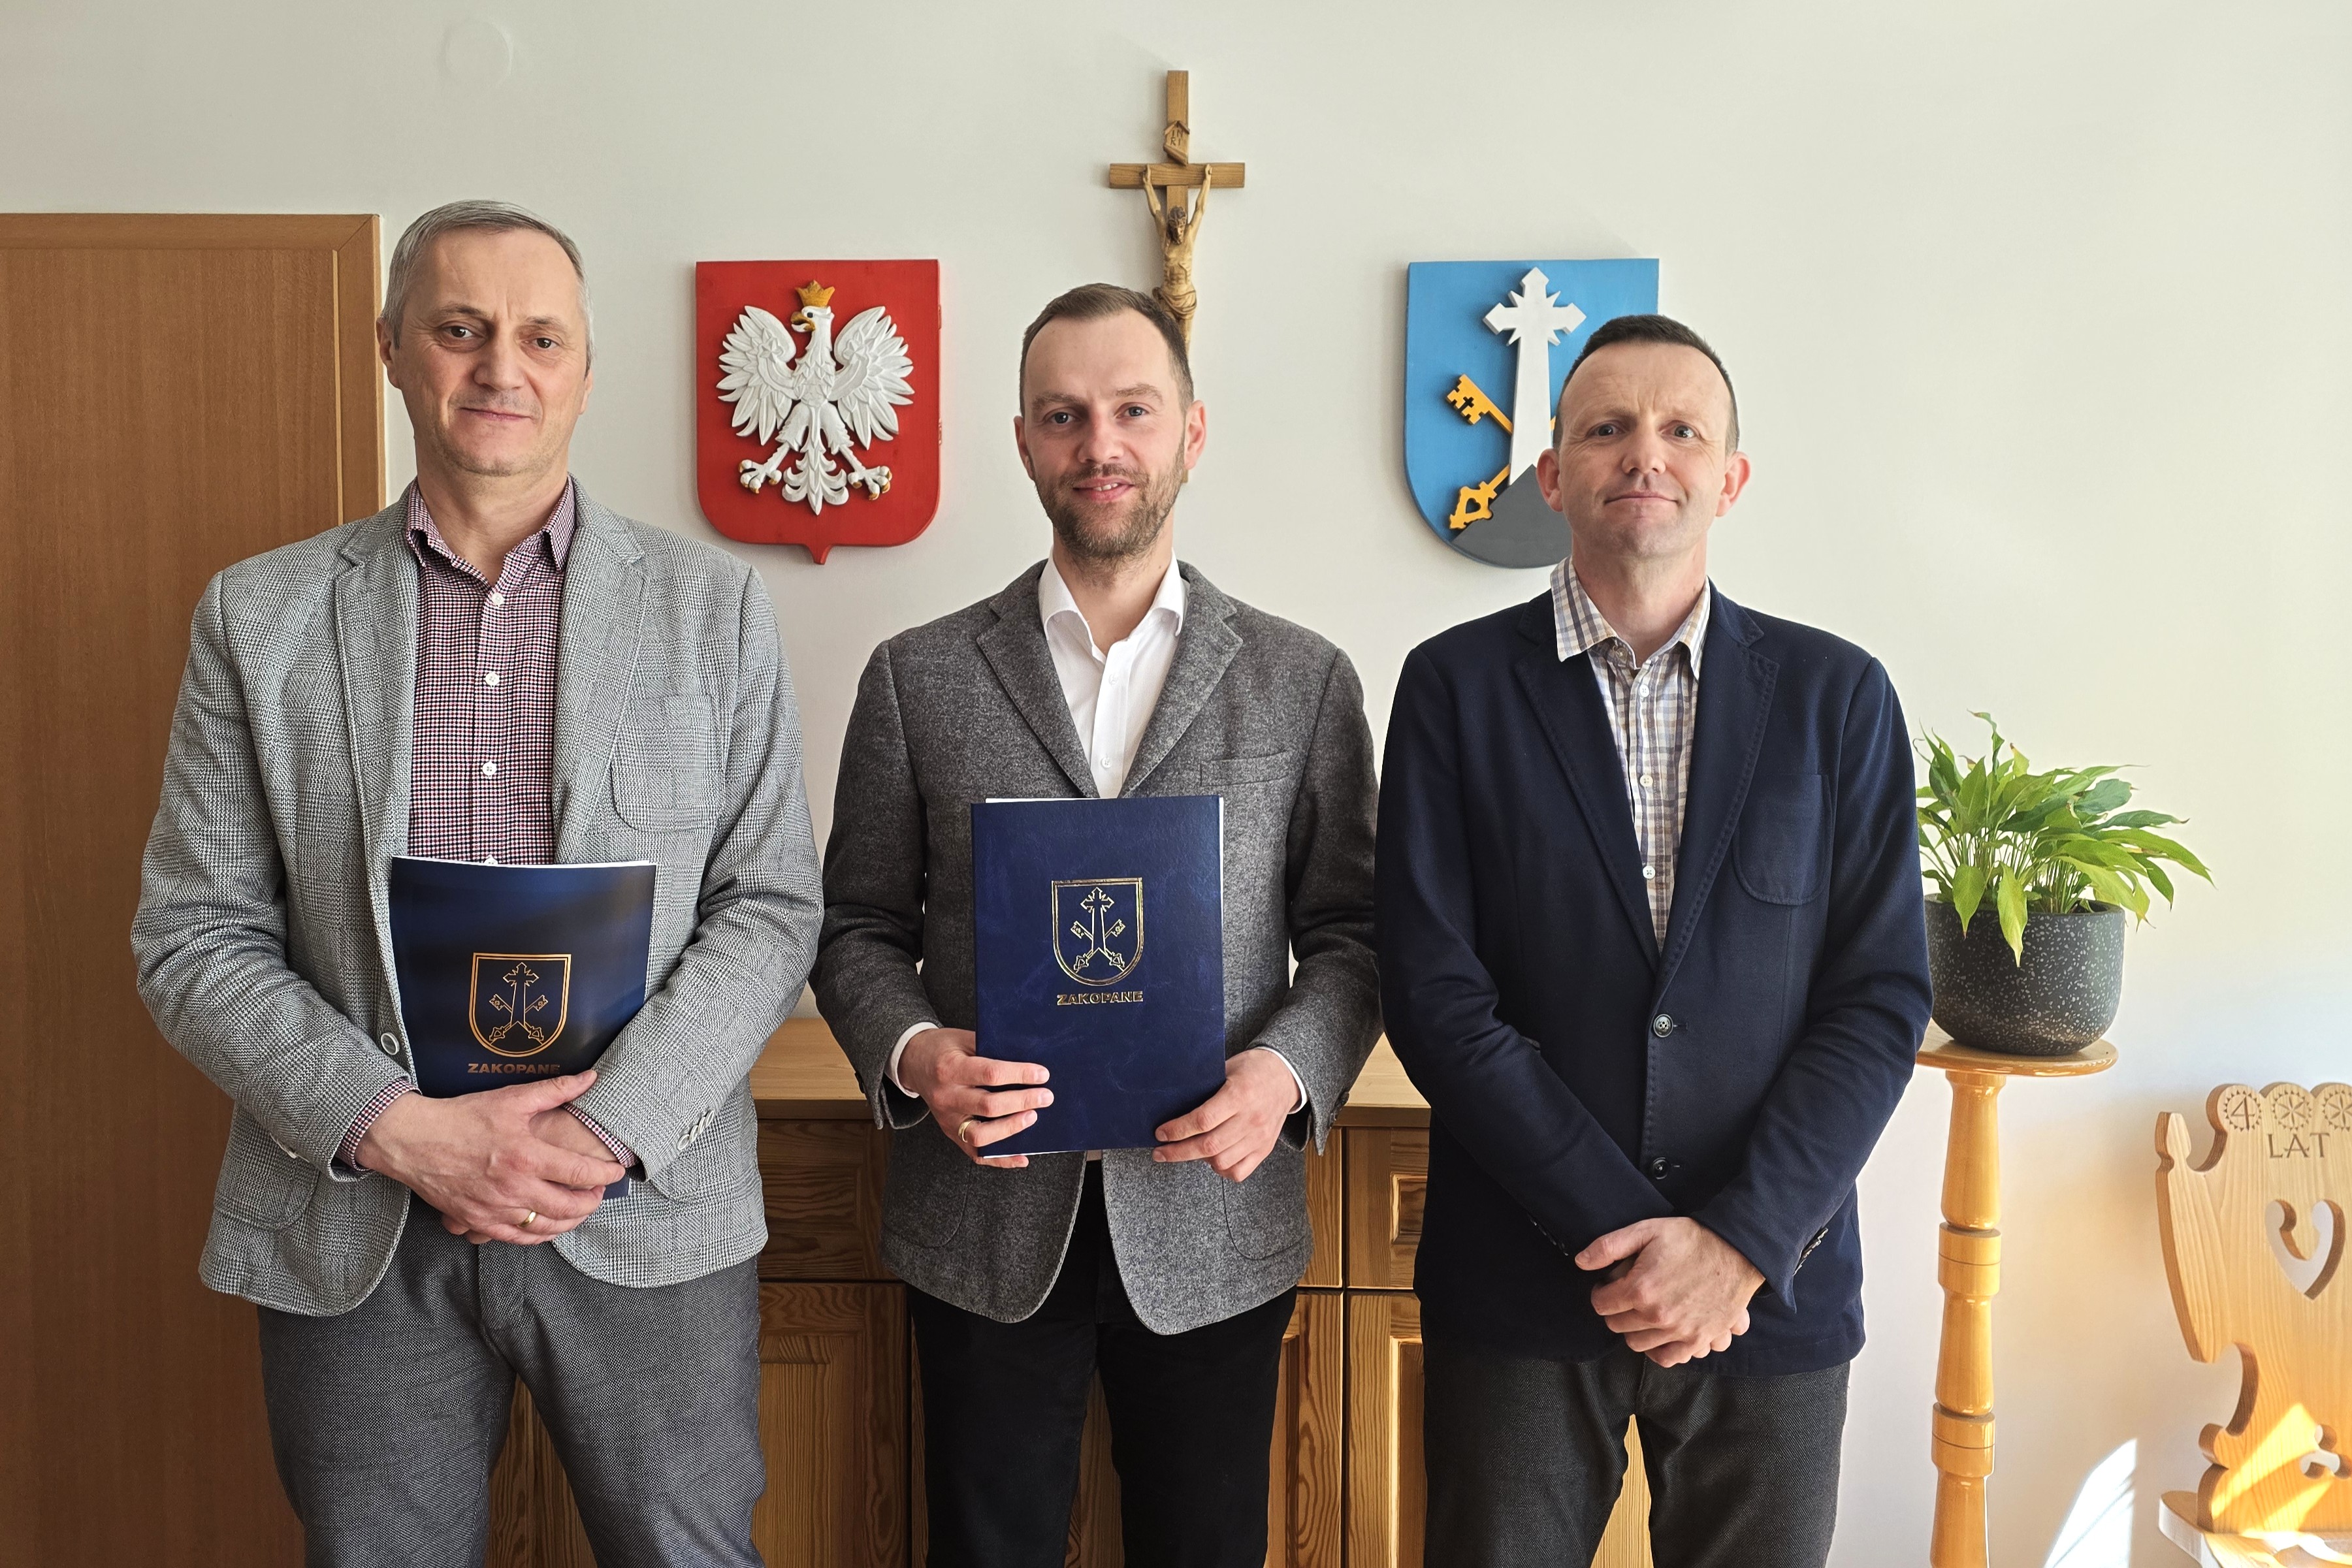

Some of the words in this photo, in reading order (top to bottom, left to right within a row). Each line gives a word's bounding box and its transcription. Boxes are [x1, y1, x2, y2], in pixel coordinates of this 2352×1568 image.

[1057, 991, 1144, 1005] ZAKOPANE
[467, 1063, 560, 1074] ZAKOPANE
[2268, 1132, 2330, 1158] LAT
